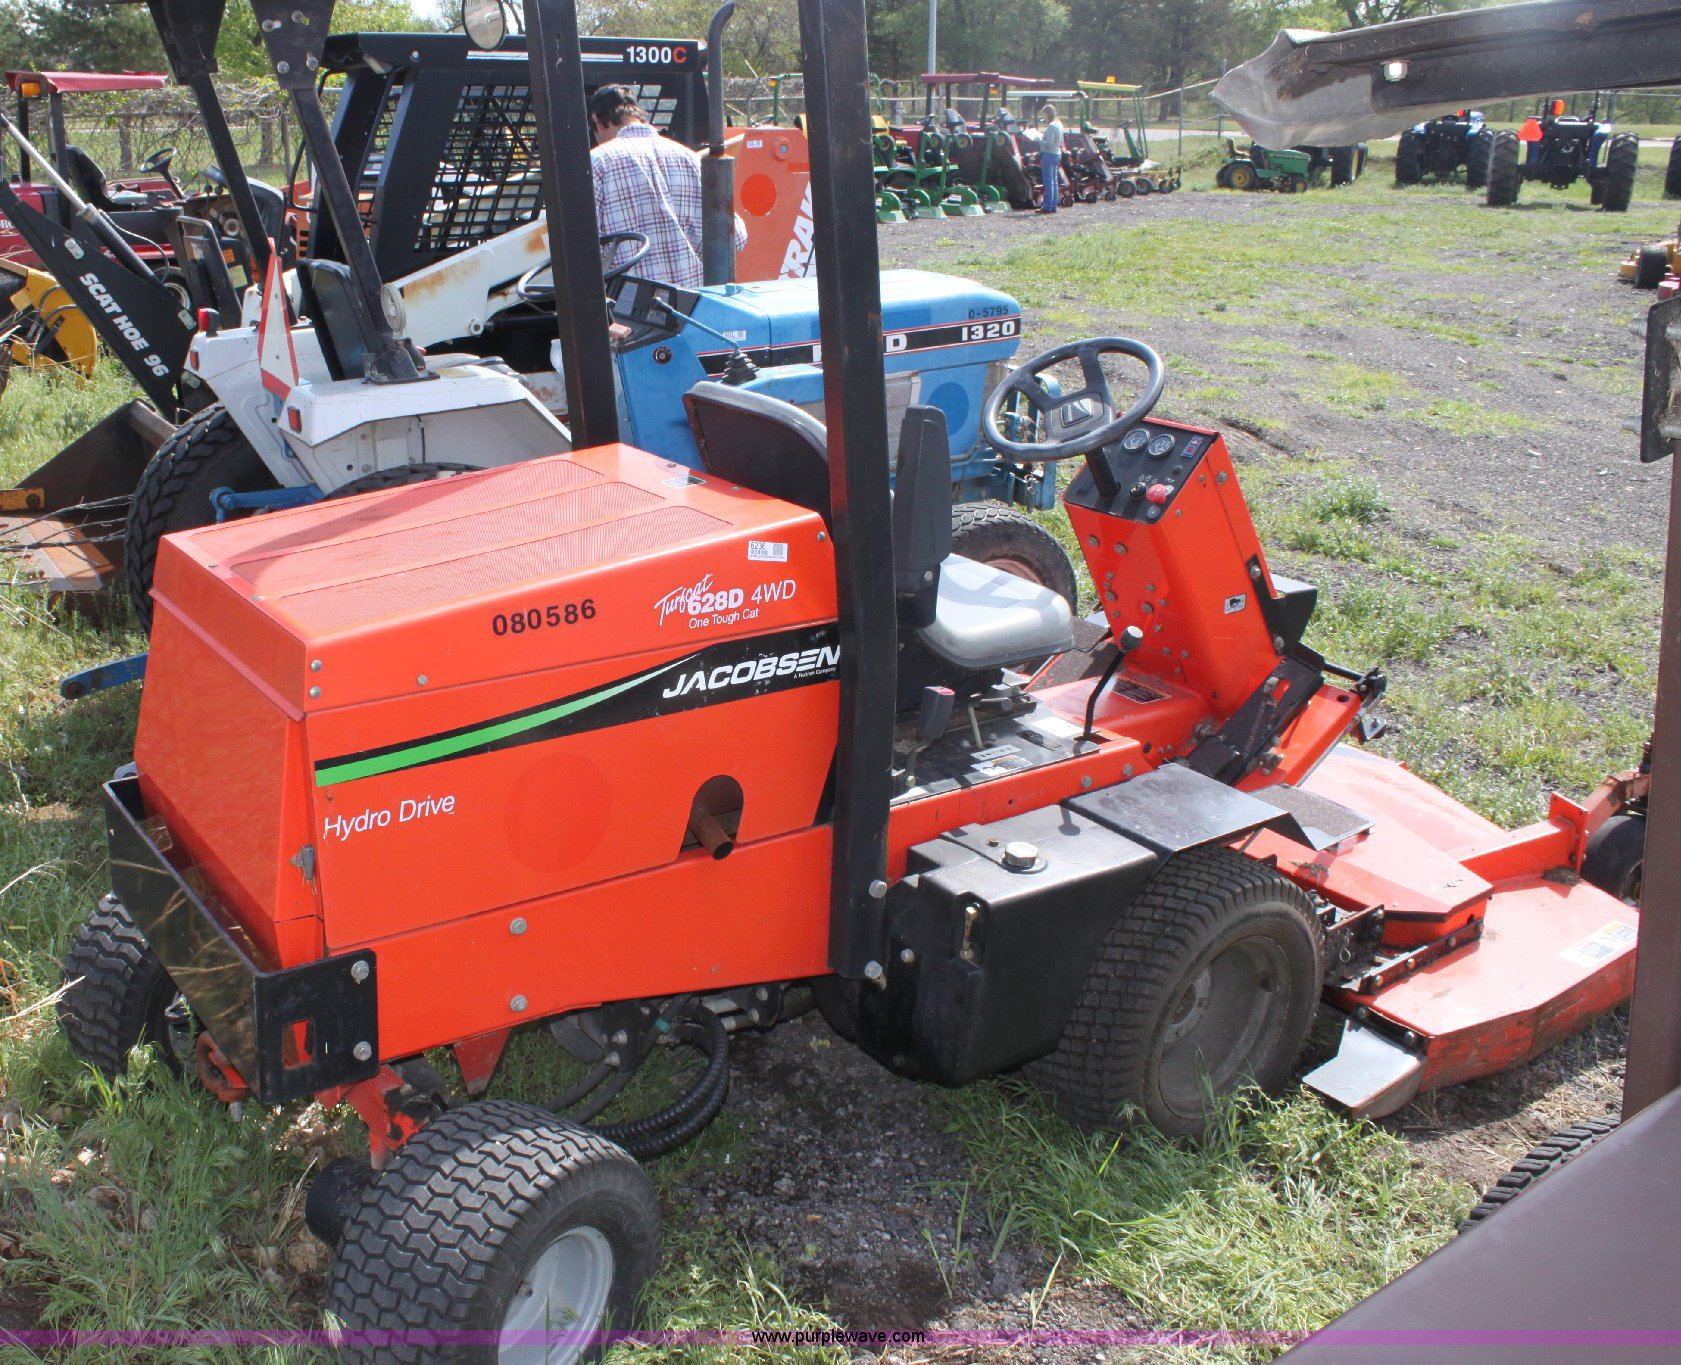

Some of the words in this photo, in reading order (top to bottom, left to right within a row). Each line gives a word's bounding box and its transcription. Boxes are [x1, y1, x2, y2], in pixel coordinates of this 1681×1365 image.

[626, 45, 687, 64] 1300C
[80, 273, 123, 314] SCAT
[112, 315, 150, 351] HOE
[143, 354, 170, 377] 96
[961, 320, 1015, 342] 1320
[492, 598, 596, 636] 080586
[653, 573, 714, 626] Turfcat
[687, 588, 744, 615] 628D
[751, 579, 797, 604] 4WD
[688, 617, 710, 629] One
[712, 611, 740, 625] Tough
[742, 607, 760, 620] Cat
[662, 644, 840, 699] JACOBSEN
[815, 667, 837, 675] Company
[322, 808, 391, 842] Hydro
[399, 794, 456, 823] Drive
